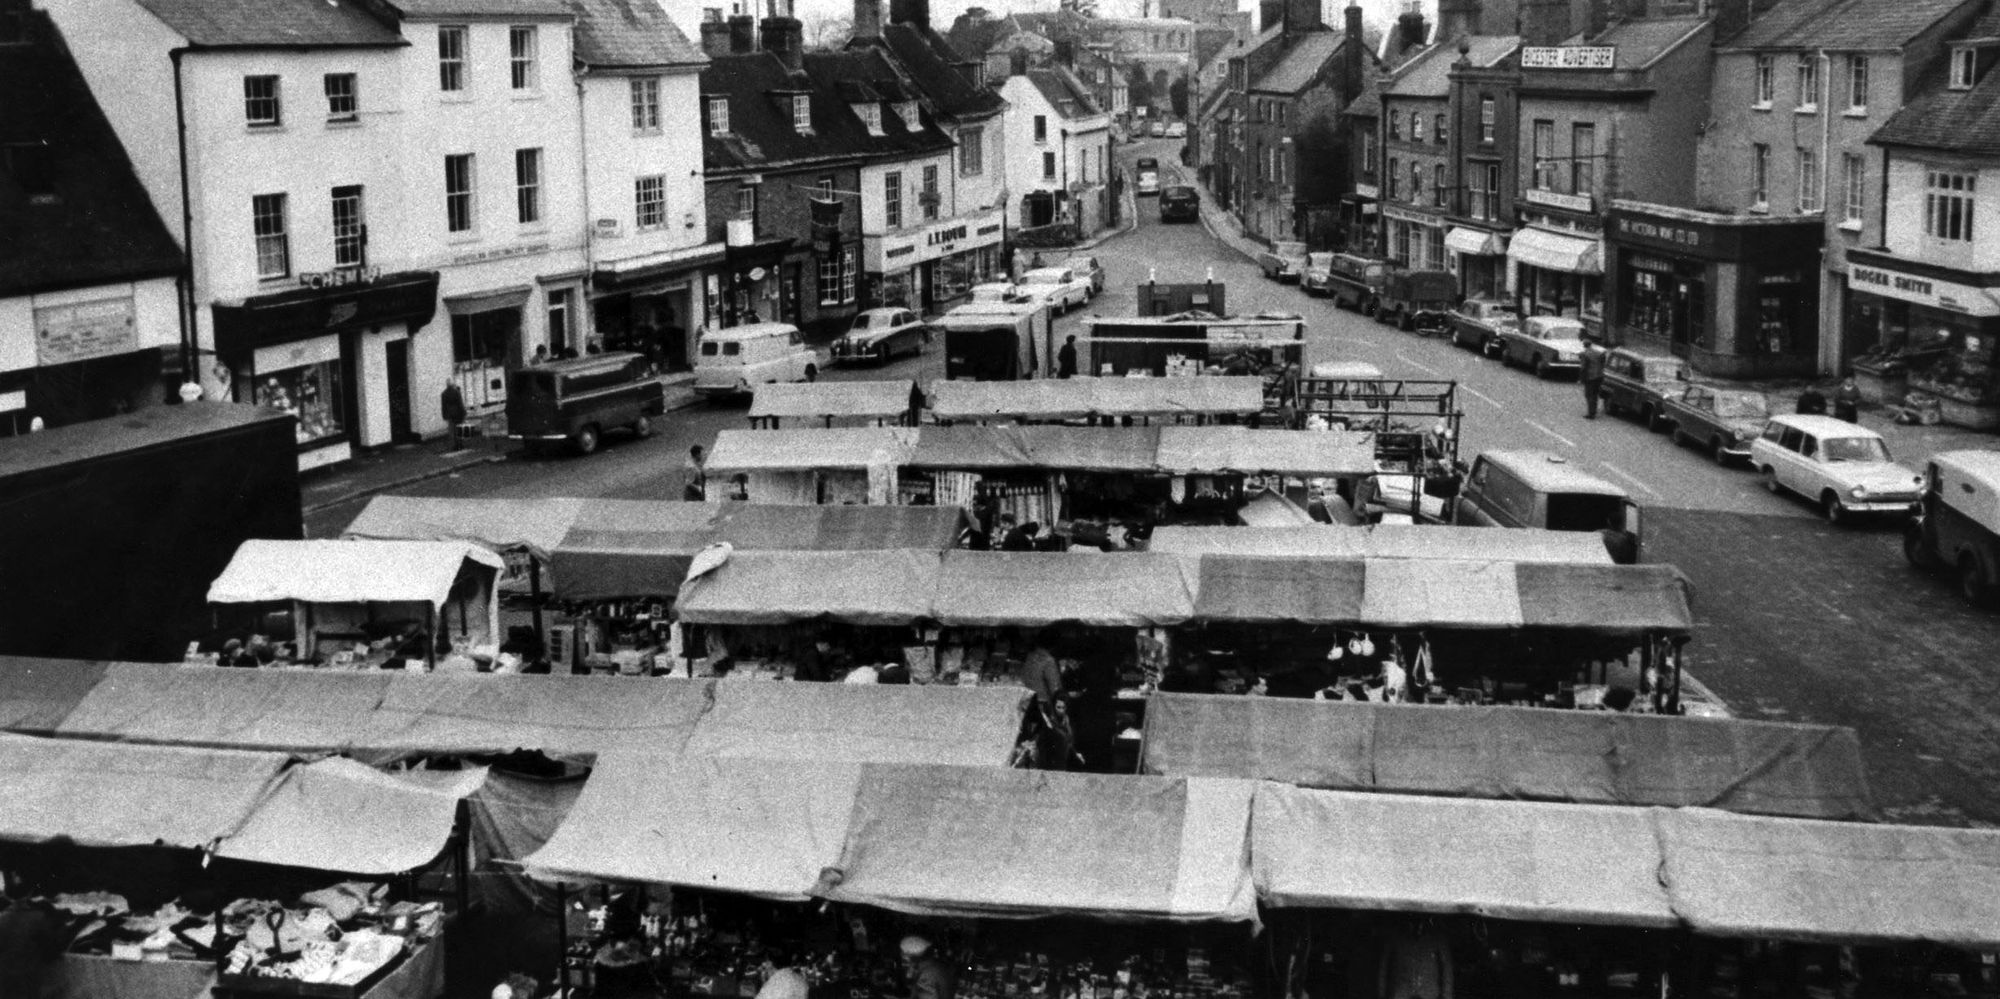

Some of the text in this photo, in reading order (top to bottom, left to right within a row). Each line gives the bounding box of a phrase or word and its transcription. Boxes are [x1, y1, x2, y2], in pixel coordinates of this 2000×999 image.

[1523, 47, 1612, 66] BICESTER ADVERTISER
[1854, 266, 1933, 296] ROGER SMITH
